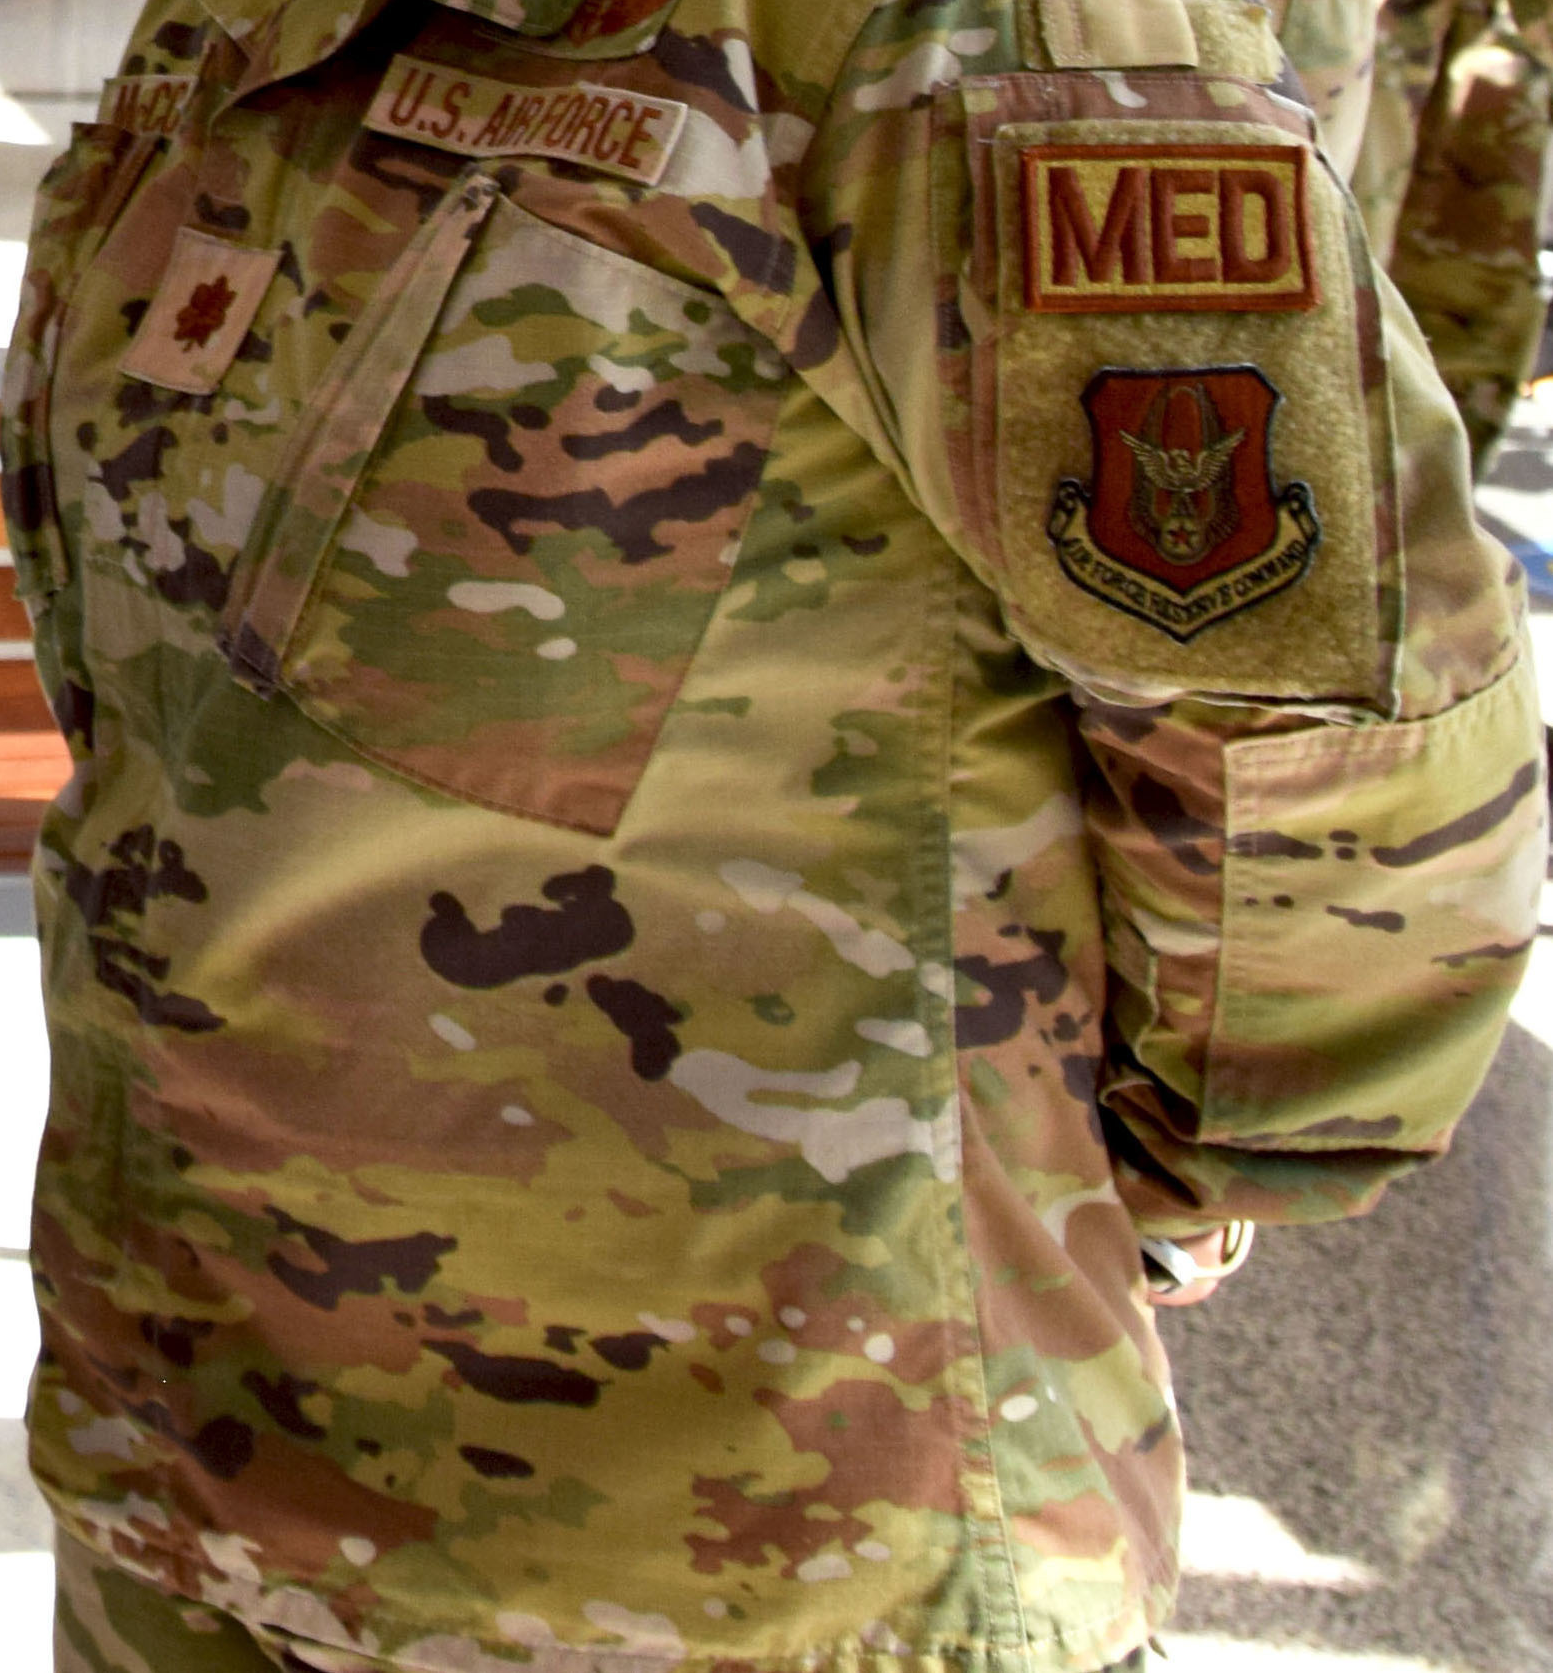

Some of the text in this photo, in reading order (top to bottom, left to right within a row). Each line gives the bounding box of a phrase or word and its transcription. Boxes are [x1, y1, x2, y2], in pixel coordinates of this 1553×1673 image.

[388, 66, 664, 170] U.S. AIR FORCE
[1047, 166, 1292, 286] MED
